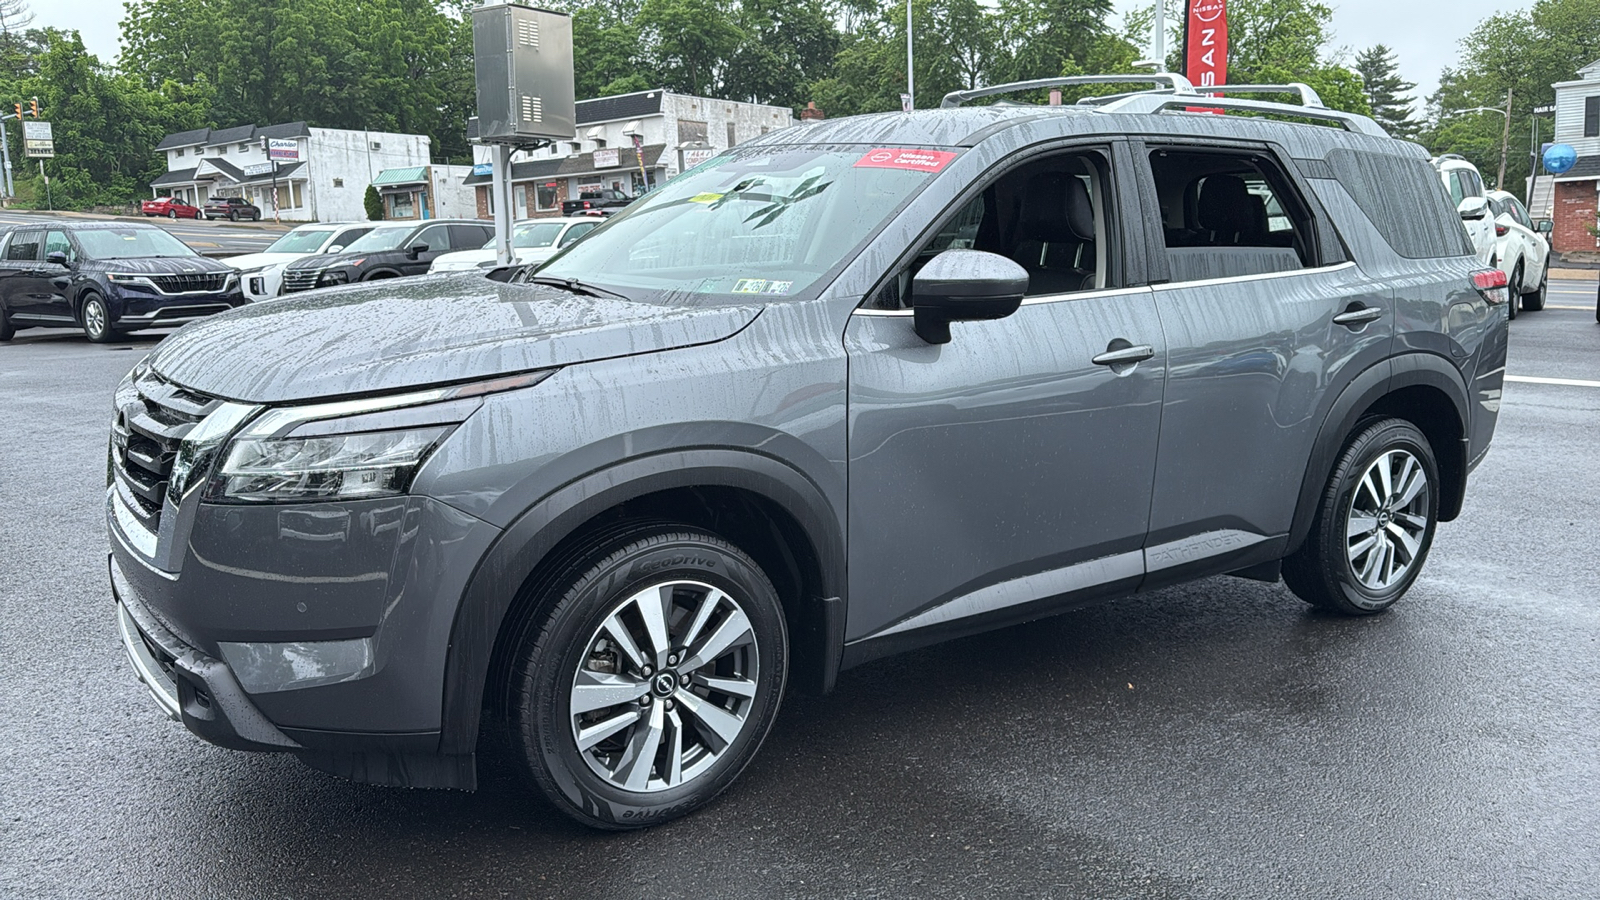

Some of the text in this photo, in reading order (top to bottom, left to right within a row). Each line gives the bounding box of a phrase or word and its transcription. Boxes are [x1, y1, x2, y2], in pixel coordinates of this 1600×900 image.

[1193, 4, 1223, 14] NISSAN
[894, 158, 941, 167] Certified
[1150, 533, 1242, 562] PATHFINDER
